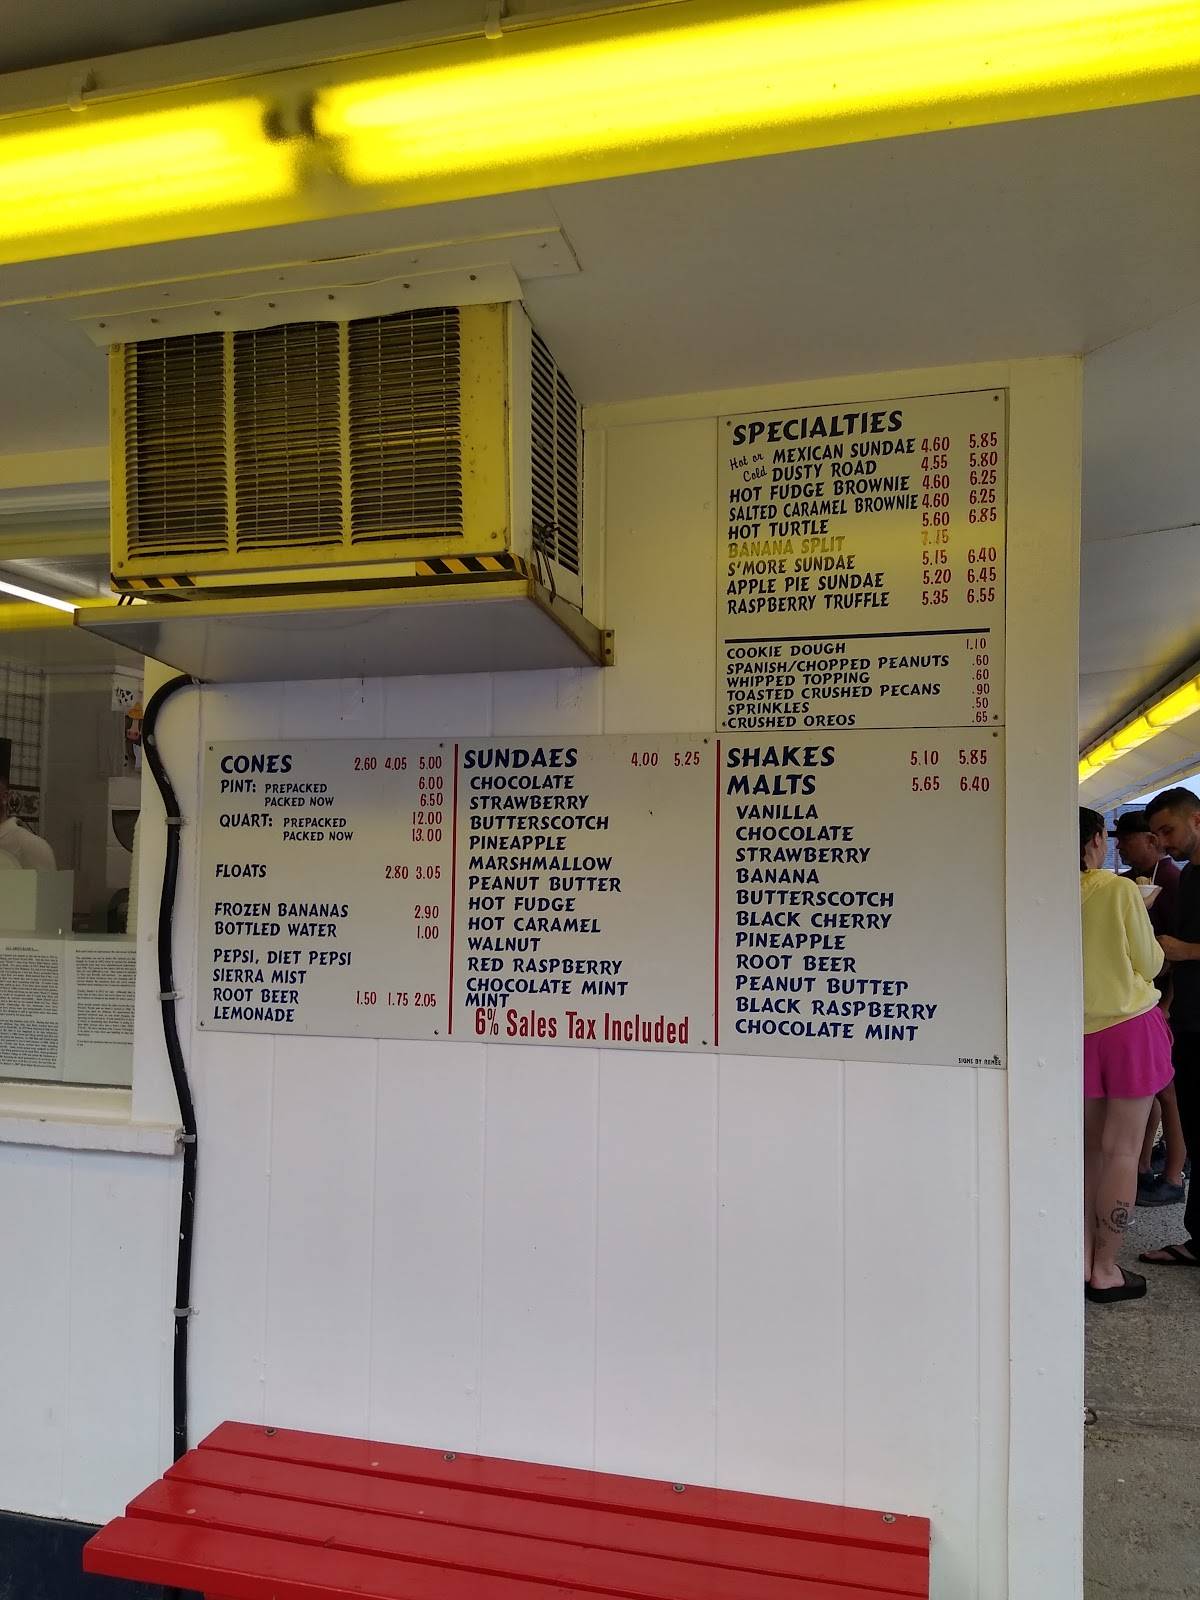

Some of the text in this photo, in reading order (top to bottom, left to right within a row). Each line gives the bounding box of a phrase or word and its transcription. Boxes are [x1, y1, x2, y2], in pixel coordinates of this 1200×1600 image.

[732, 410, 903, 446] SPECIALTIES
[772, 432, 998, 465] MEXICAN SUNDAE 4.60 5.85
[729, 453, 764, 471] Hot or
[772, 451, 998, 483] DUSTY ROAD 4.55 5.80
[743, 465, 768, 482] Cold
[729, 469, 997, 504] HOT FUDGE BROWNIE 4.60 6.25
[728, 488, 996, 522] SALTED CARAMEL BROWNIE 4.60 6.25
[728, 507, 997, 540] HOT TURTLE 5.60 6.85
[728, 538, 794, 559] BANANA
[801, 535, 846, 554] SPLIT
[728, 547, 997, 577] S'MORE SUNDAE 5.15 6.40
[726, 567, 997, 596] APPLE PIE SUNDAE 5.20 6.45
[727, 587, 995, 615] RASPBERRY TRUFFLE 5.35 6.55
[726, 638, 987, 659] COOKIE DOUGH 1.10
[726, 655, 990, 675] SPANISH/CHOPPED PEANUTS .60
[726, 668, 990, 688] WHIPPED TOPPING .60
[727, 683, 990, 701] TOASTED CRUSHED PECANS .90
[727, 697, 989, 715] SPRINKLES .50
[727, 711, 988, 729] CRUSHED OREOS .65
[220, 754, 442, 774] CONES 2.60 4.05 5.00
[463, 748, 701, 769] SUNDAES 4.00 5.25
[726, 745, 988, 768] SHAKES 5.10 5.85
[220, 776, 443, 794] PINT: PREPACKED 6.00
[470, 774, 575, 790] CHOCOLATE
[726, 773, 990, 796] MALTS 5.65 6.40
[264, 793, 444, 807] PACKED NOW 6.50
[469, 794, 590, 810] STRAWBERRY
[219, 811, 442, 828] QUART: PREPACKED 12.00
[736, 804, 819, 820] VANILLA
[469, 815, 609, 830] BUTTERSCOTCH
[283, 828, 442, 842] PACKED NOW 13.00
[735, 825, 854, 842] CHOCOLATE
[469, 835, 567, 851] PINEAPPLE
[469, 855, 613, 871] MARSHMALLOW
[735, 847, 871, 864] STRAWBERRY
[215, 864, 441, 880] FLOATS 2.80 3.05
[736, 868, 820, 884] BANANA
[469, 875, 622, 893] PEANUT BUTTER
[468, 896, 576, 913] HOT FUDGE
[736, 889, 894, 908] BUTTERSCOTCH
[214, 902, 439, 919] FROZEN BANANAS 2.90
[468, 916, 601, 933] HOT CARAMEL
[736, 911, 892, 930] BLACK CHERRY
[214, 921, 439, 940] BOTTLED WATER 1.00
[468, 937, 542, 952] WALNUT
[735, 932, 846, 950] PINEAPPLE
[213, 949, 352, 966] PEPSI, DIET PEPSI
[467, 957, 623, 975] RED RASPBERRY
[736, 954, 857, 974] ROOT BEER
[212, 968, 307, 984] SIERRA MIST
[735, 976, 816, 993] PEANUT
[466, 977, 629, 996] CHOCOLATE MINT
[213, 987, 437, 1007] ROOT BEER 1.50 1.75 2.05
[465, 992, 510, 1008] MINT
[213, 1006, 295, 1022] LEMONADE
[736, 997, 938, 1020] BLACK RASPBERRY
[475, 1007, 689, 1044] 6% Sales Tax Included
[735, 1019, 919, 1042] CHOCOLATE MINT
